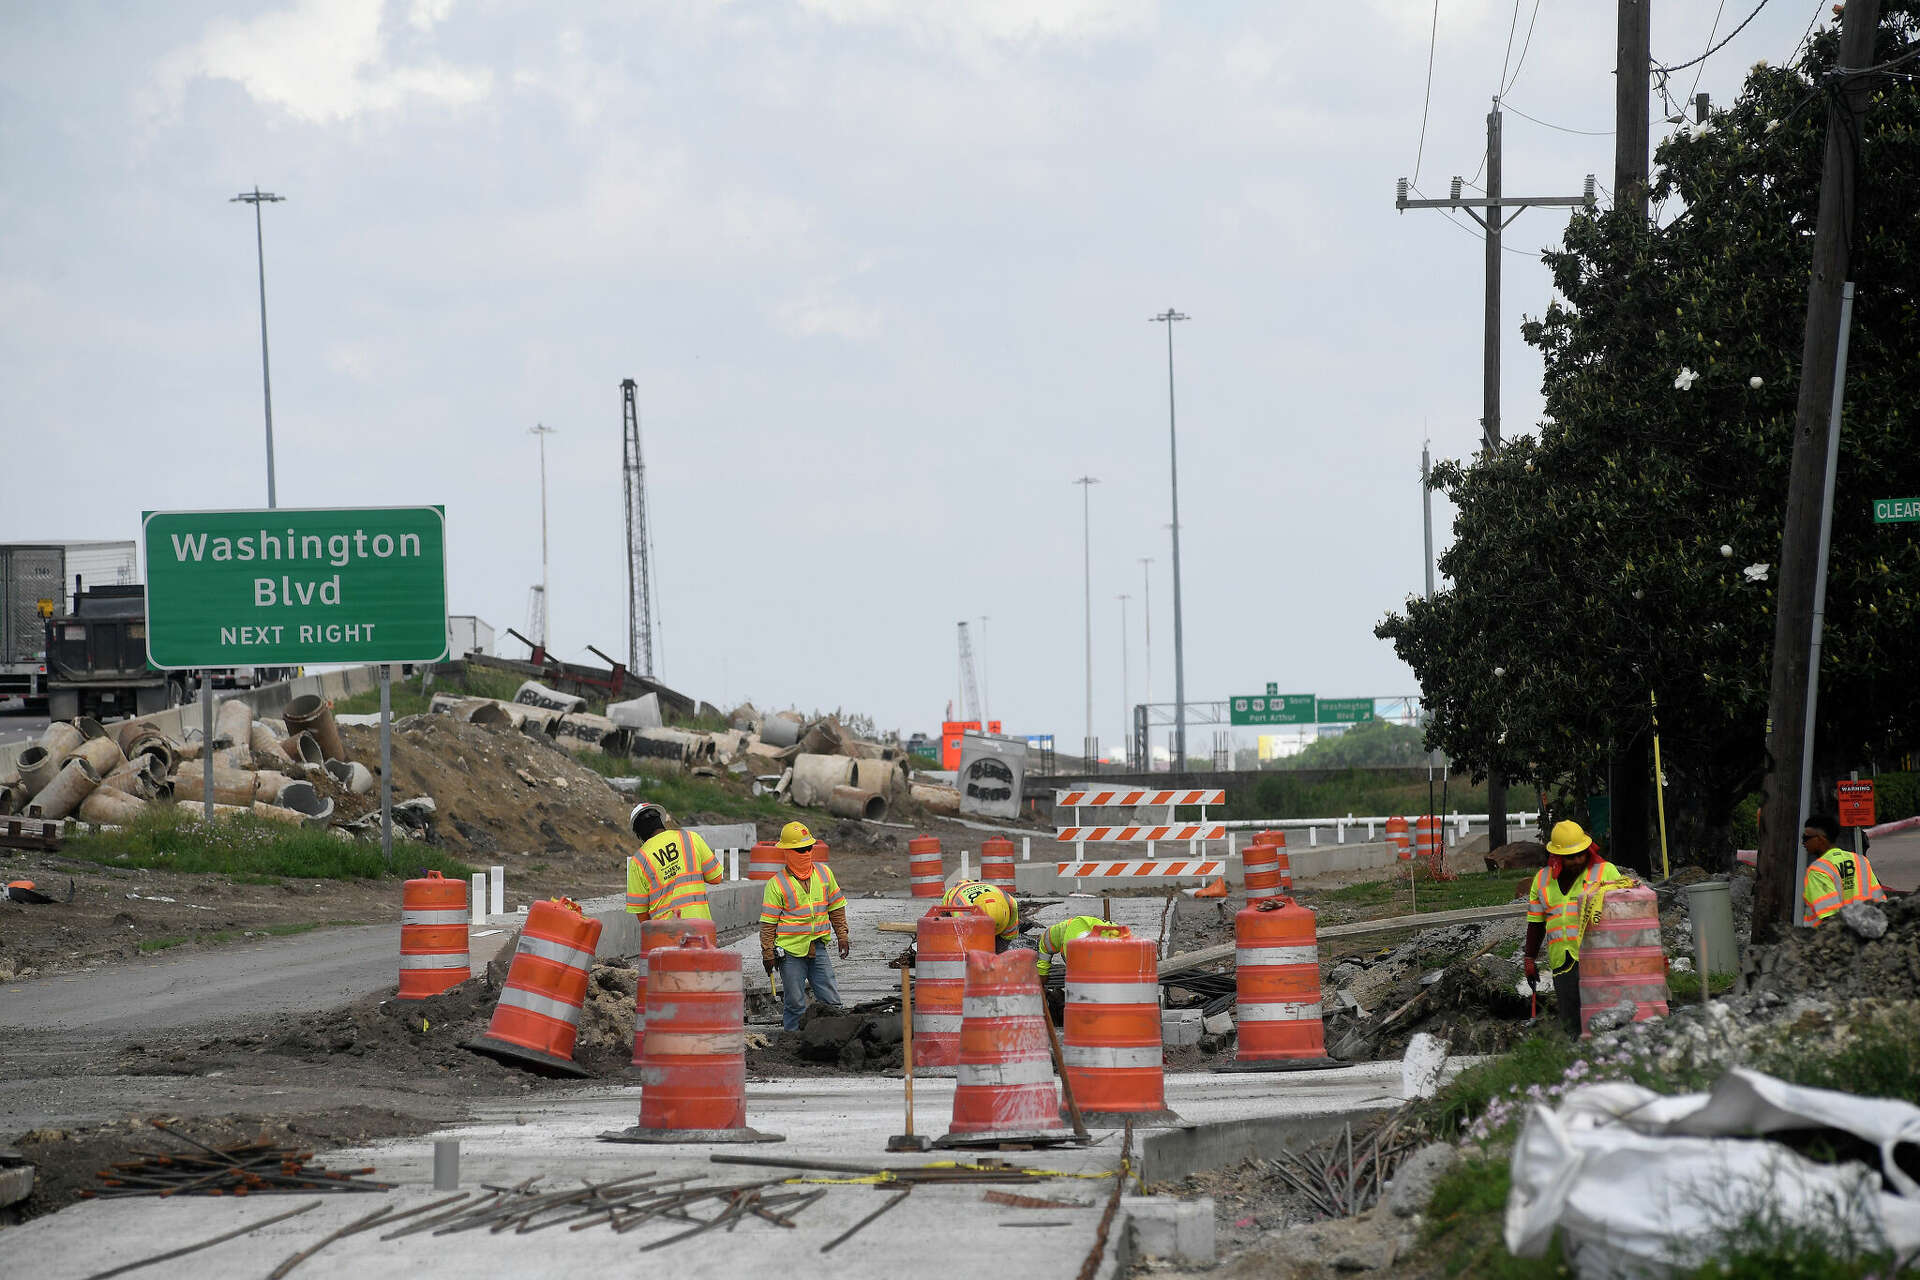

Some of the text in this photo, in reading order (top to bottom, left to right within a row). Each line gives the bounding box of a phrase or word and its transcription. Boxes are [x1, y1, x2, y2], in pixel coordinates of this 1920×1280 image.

[1877, 502, 1920, 519] CLEAR
[171, 528, 421, 567] Washington
[254, 574, 341, 607] Blvd
[220, 623, 375, 645] NEXT RIGHT
[1321, 703, 1370, 711] Washington
[1336, 712, 1355, 720] Blvd
[1249, 714, 1297, 722] Port Arthur
[652, 842, 680, 867] WB
